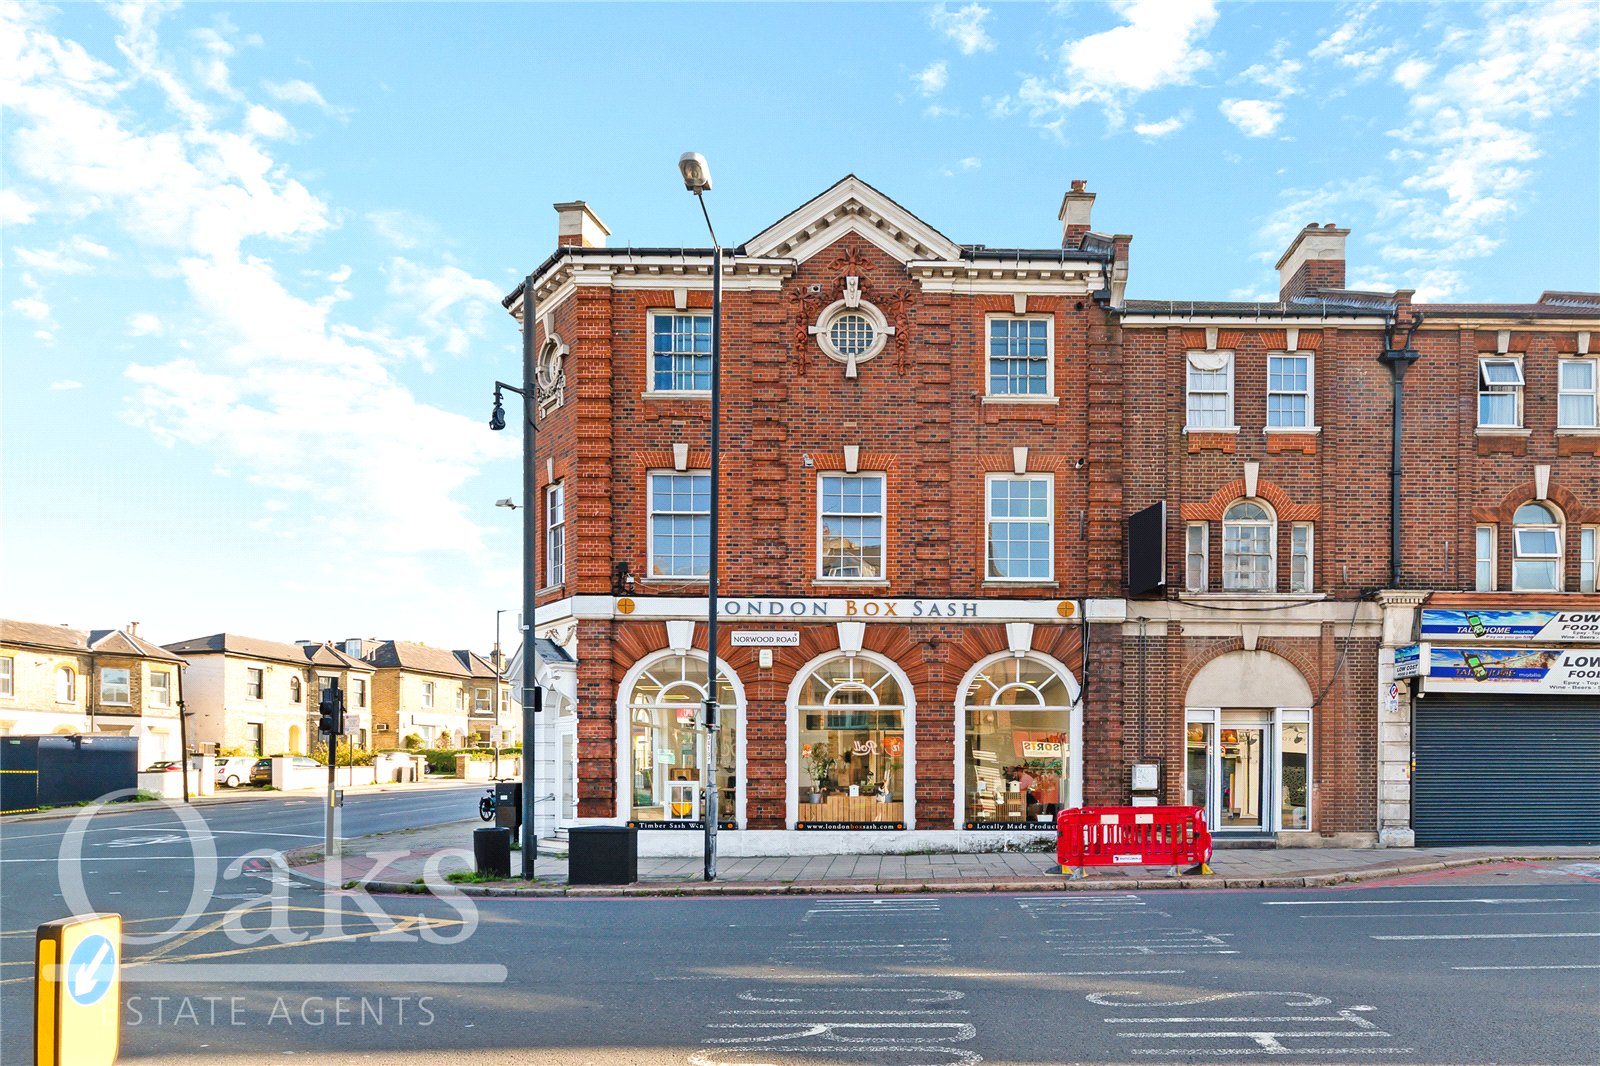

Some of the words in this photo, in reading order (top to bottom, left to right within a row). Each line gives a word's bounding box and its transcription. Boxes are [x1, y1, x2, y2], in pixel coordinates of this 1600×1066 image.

[716, 600, 828, 616] ONDON
[845, 599, 898, 616] BOX
[912, 600, 978, 617] SASH
[1558, 614, 1600, 623] LOW
[1482, 626, 1511, 635] HOME
[976, 823, 1004, 831] Locally
